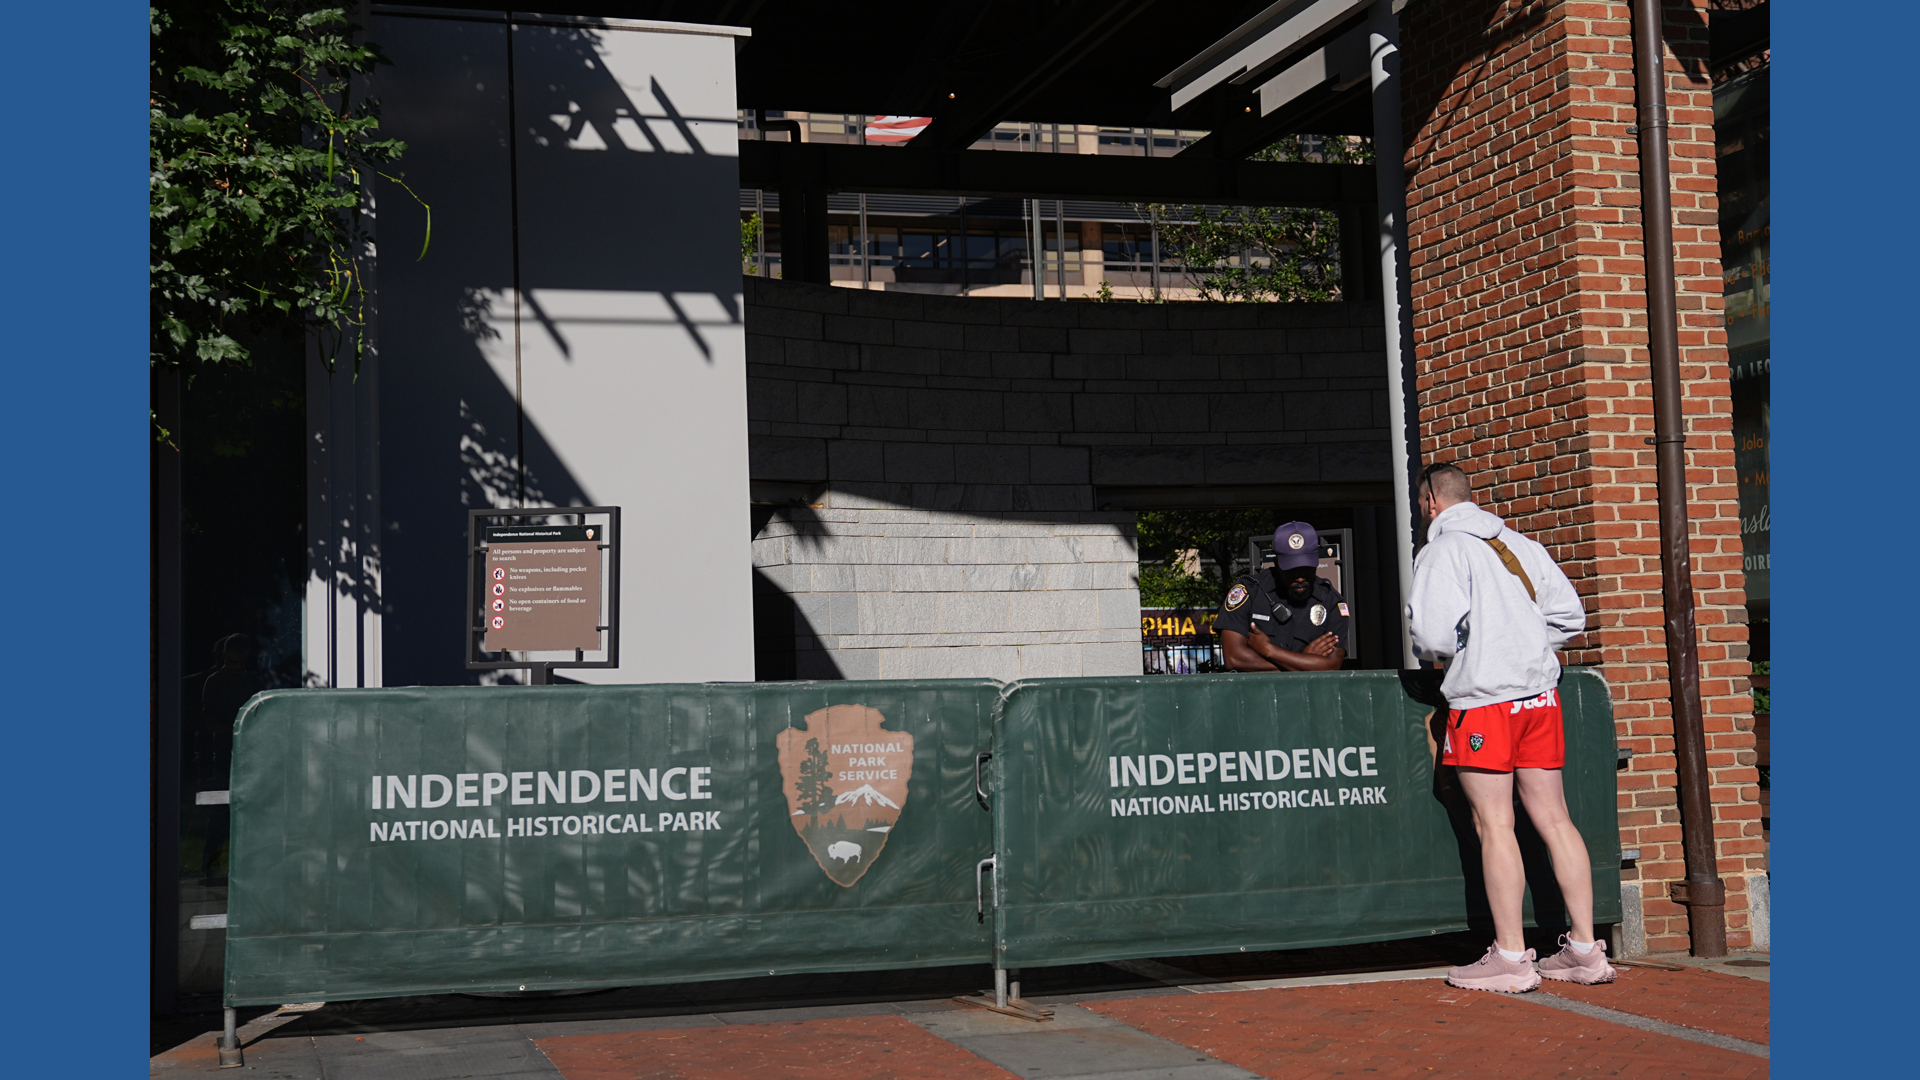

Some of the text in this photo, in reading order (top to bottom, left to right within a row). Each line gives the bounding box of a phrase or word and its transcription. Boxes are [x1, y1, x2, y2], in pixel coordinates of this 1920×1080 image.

[1741, 433, 1764, 451] Jola
[544, 566, 568, 574] including
[569, 566, 587, 574] pocket
[831, 742, 904, 755] NATIONAL
[849, 756, 887, 768] PARK
[1109, 746, 1378, 788] INDEPENDENCE
[838, 769, 898, 782] SERVICE
[371, 766, 712, 809] INDEPENDENCE
[1110, 786, 1388, 817] NATIONAL HISTORICAL PARK
[369, 810, 722, 842] NATIONAL HISTORICAL PARK
